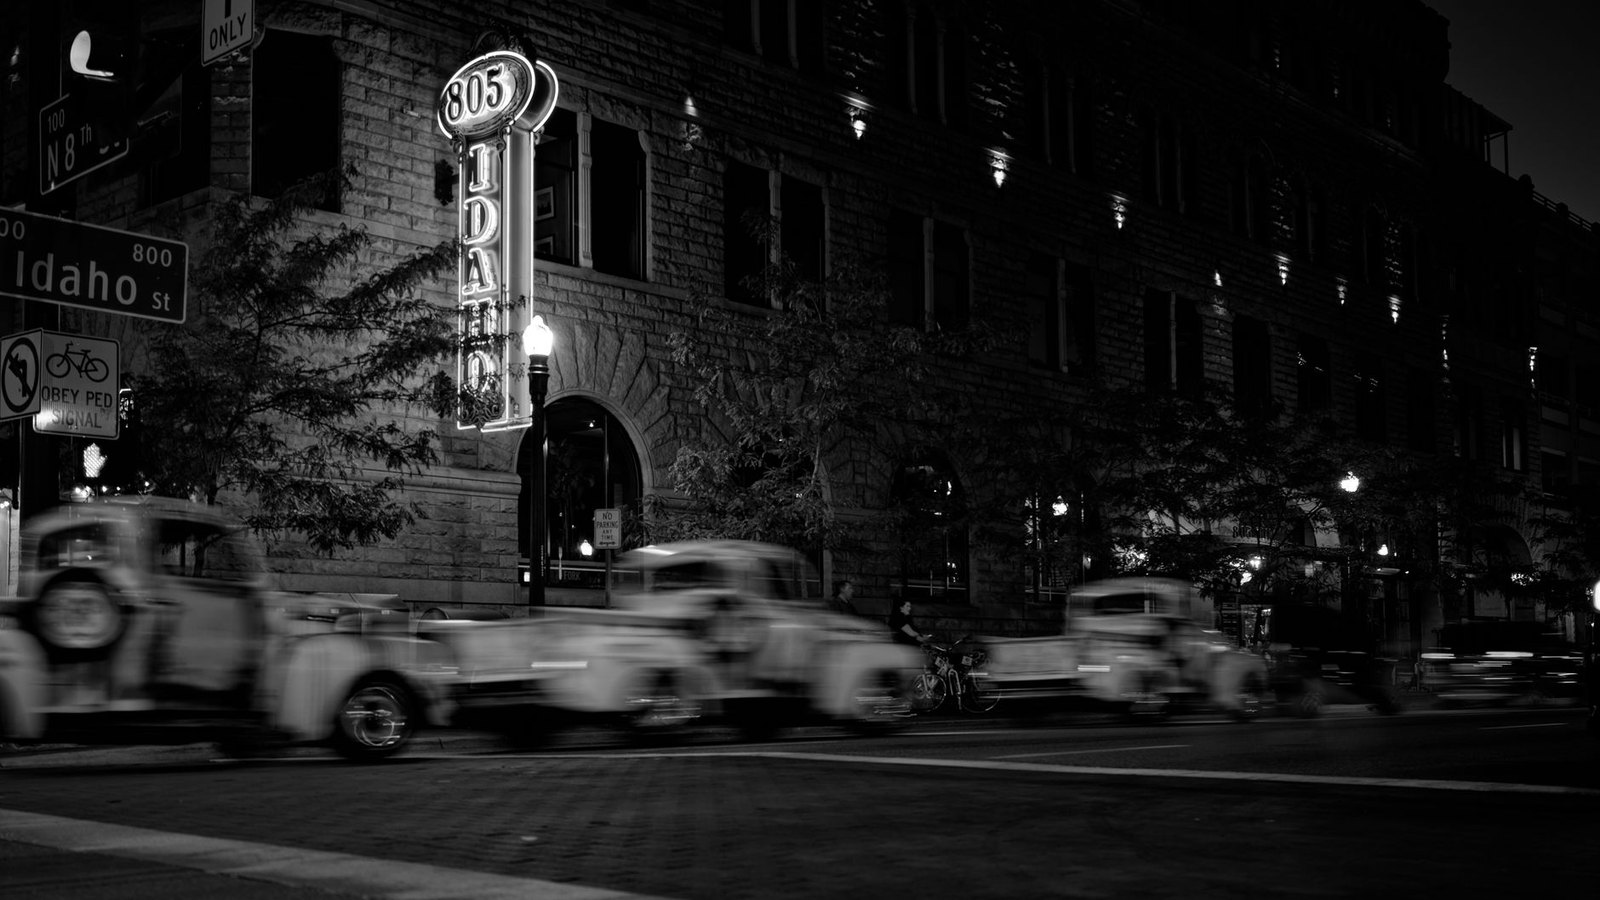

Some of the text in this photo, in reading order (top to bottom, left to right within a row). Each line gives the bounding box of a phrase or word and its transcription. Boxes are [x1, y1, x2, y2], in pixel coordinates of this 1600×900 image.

[210, 13, 246, 50] ONLY
[445, 62, 506, 126] 805
[48, 108, 65, 134] 100
[47, 139, 59, 182] N
[132, 243, 173, 268] 800
[16, 250, 171, 312] Idaho St
[461, 143, 497, 398] IDAHO
[41, 385, 113, 409] OBEY PED
[51, 409, 102, 429] SIGNAL
[596, 521, 619, 529] PARKING
[602, 512, 613, 521] NO
